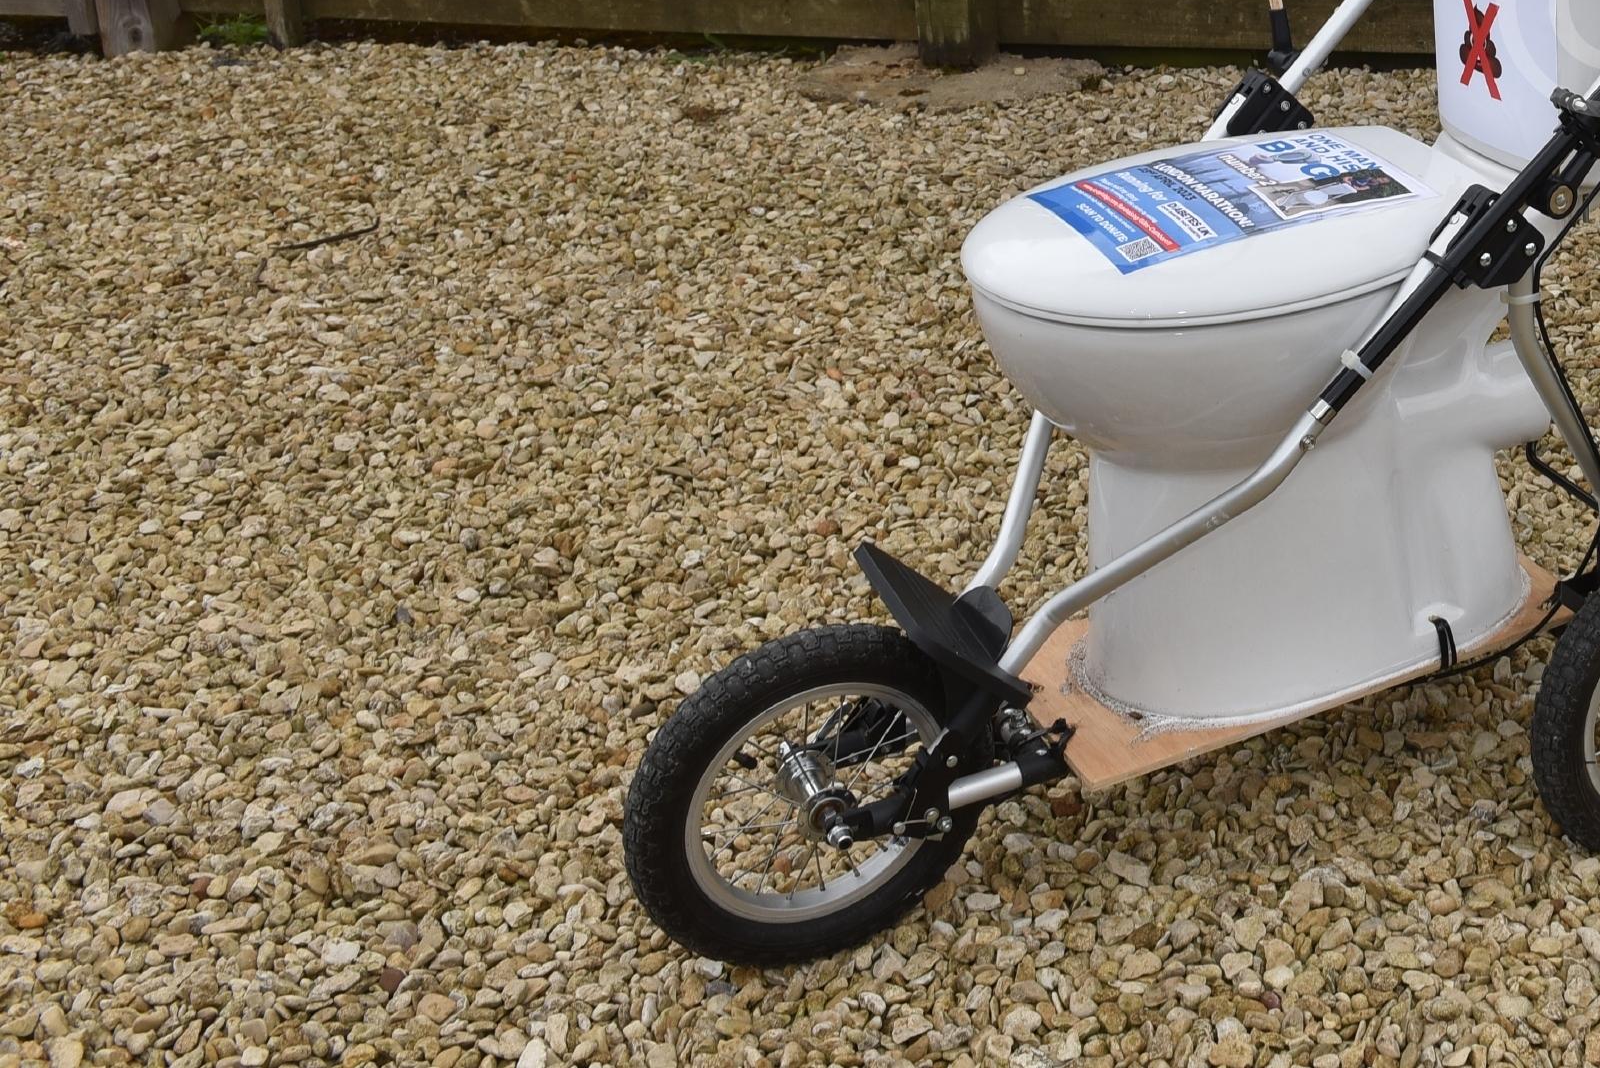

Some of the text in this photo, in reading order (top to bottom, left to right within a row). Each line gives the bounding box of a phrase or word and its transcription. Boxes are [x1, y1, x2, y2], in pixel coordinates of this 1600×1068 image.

[1218, 154, 1267, 185] number
[1294, 138, 1362, 173] AND HIS
[1308, 134, 1383, 171] ONE MAN
[1153, 162, 1199, 188] LONDON
[1191, 182, 1254, 228] MARATHON!
